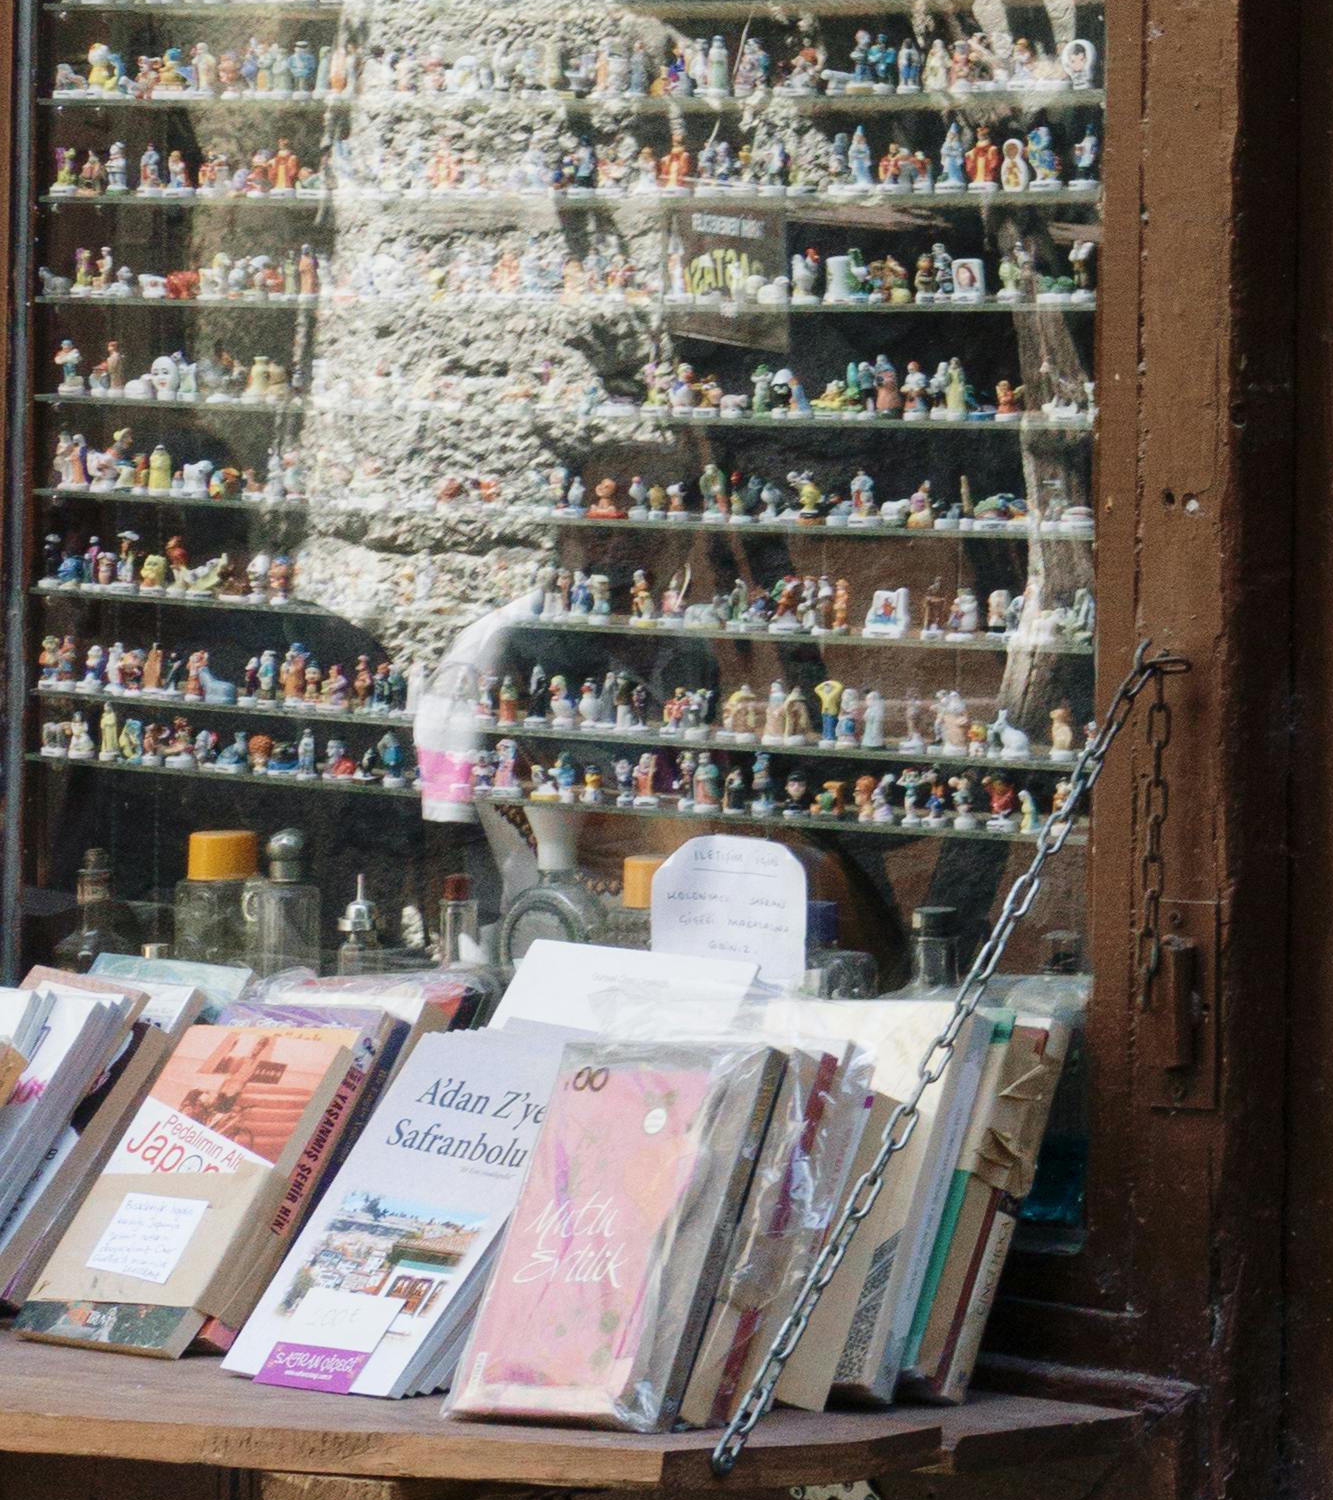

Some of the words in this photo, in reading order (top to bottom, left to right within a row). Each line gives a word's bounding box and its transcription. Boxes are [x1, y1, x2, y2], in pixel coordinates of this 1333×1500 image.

[304, 1091, 349, 1162] YAŞANMIŞ
[416, 1077, 490, 1115] A'dan
[491, 1090, 547, 1131] Z'ye
[385, 1118, 528, 1168] Safranbolu
[283, 1163, 312, 1204] ŞEHİR
[526, 1191, 619, 1249] Mutlu
